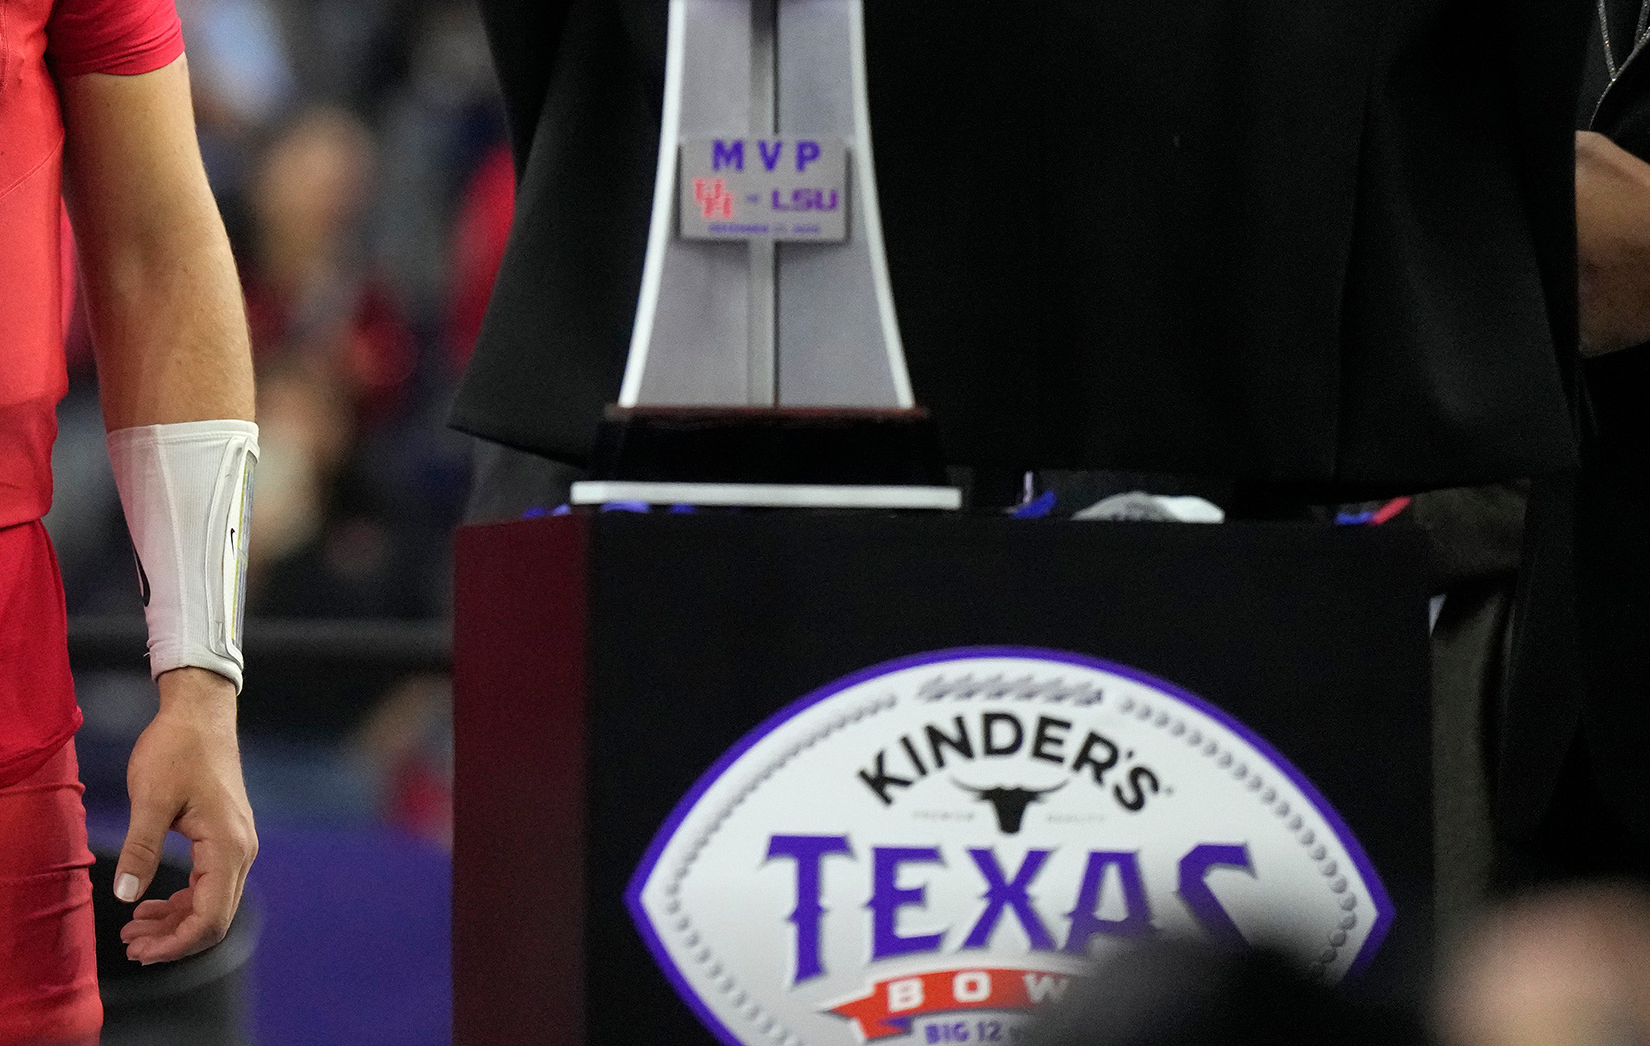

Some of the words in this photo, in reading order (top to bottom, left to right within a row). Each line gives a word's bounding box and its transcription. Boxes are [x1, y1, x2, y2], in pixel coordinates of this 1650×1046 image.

[711, 139, 822, 173] MVP
[772, 189, 839, 212] LSU
[857, 711, 1162, 813] KINDER'S
[759, 834, 1257, 988] TEXAS
[887, 970, 1068, 1012] BOW
